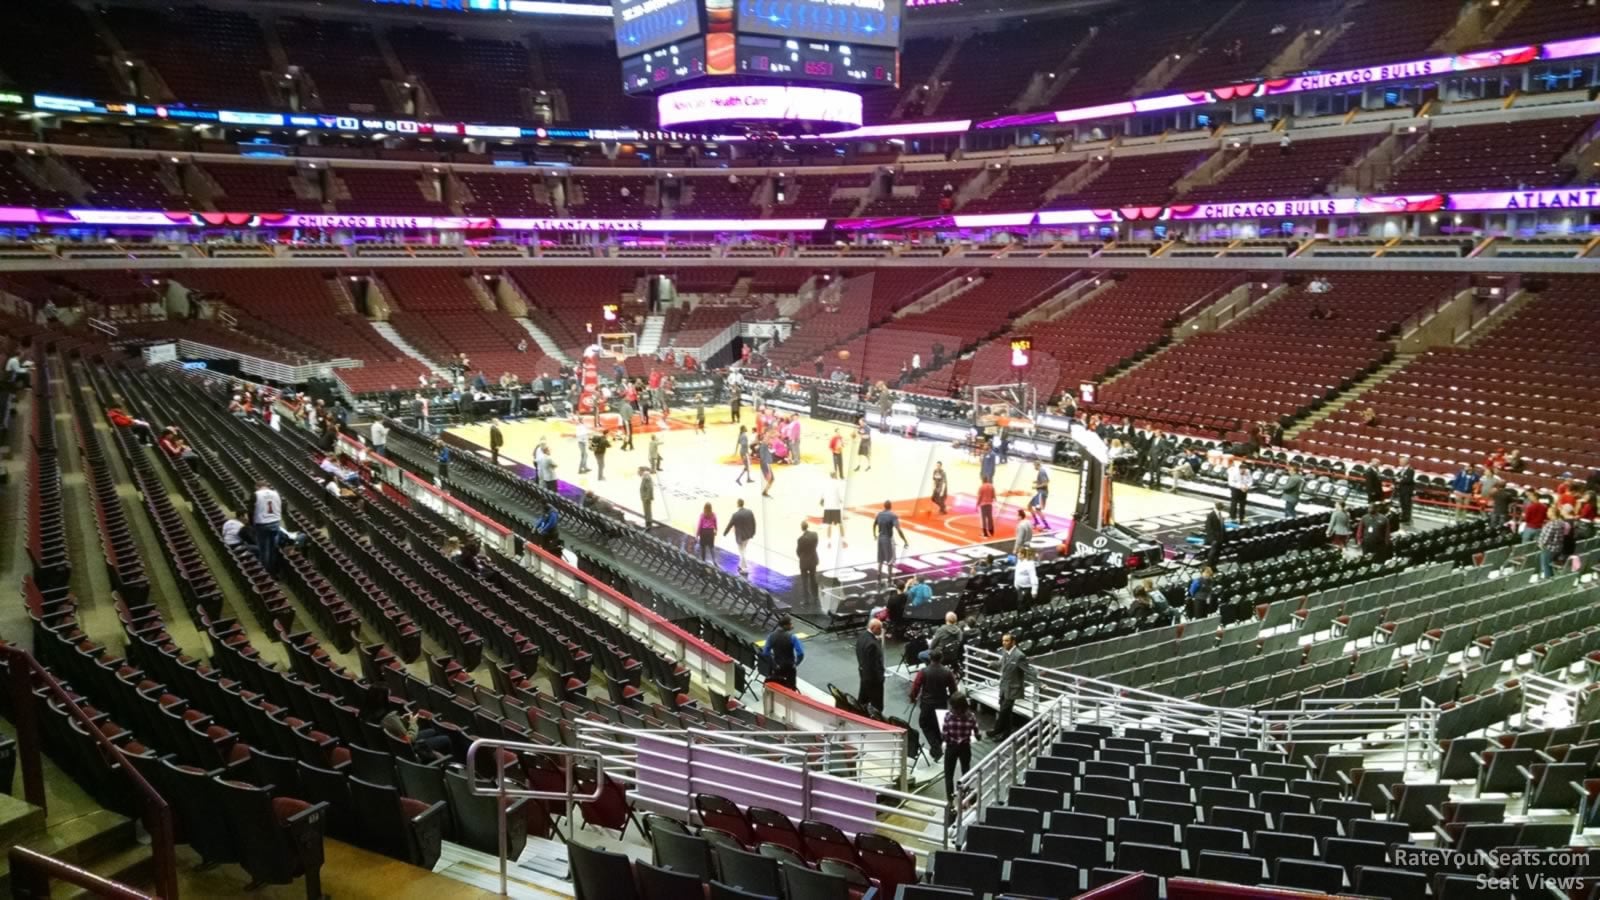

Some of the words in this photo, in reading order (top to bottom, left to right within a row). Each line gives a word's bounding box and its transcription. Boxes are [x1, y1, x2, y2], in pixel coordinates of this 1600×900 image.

[1301, 70, 1372, 90] CHICAGO
[1381, 62, 1432, 79] BULLS
[1507, 191, 1597, 208] ATLANT
[1205, 203, 1276, 218] CHICAGO
[1285, 201, 1335, 215] BULLS
[298, 216, 367, 228] CHICAGO
[375, 217, 418, 228] BULLS
[533, 220, 592, 230] ATLANTA
[267, 500, 273, 514] 1
